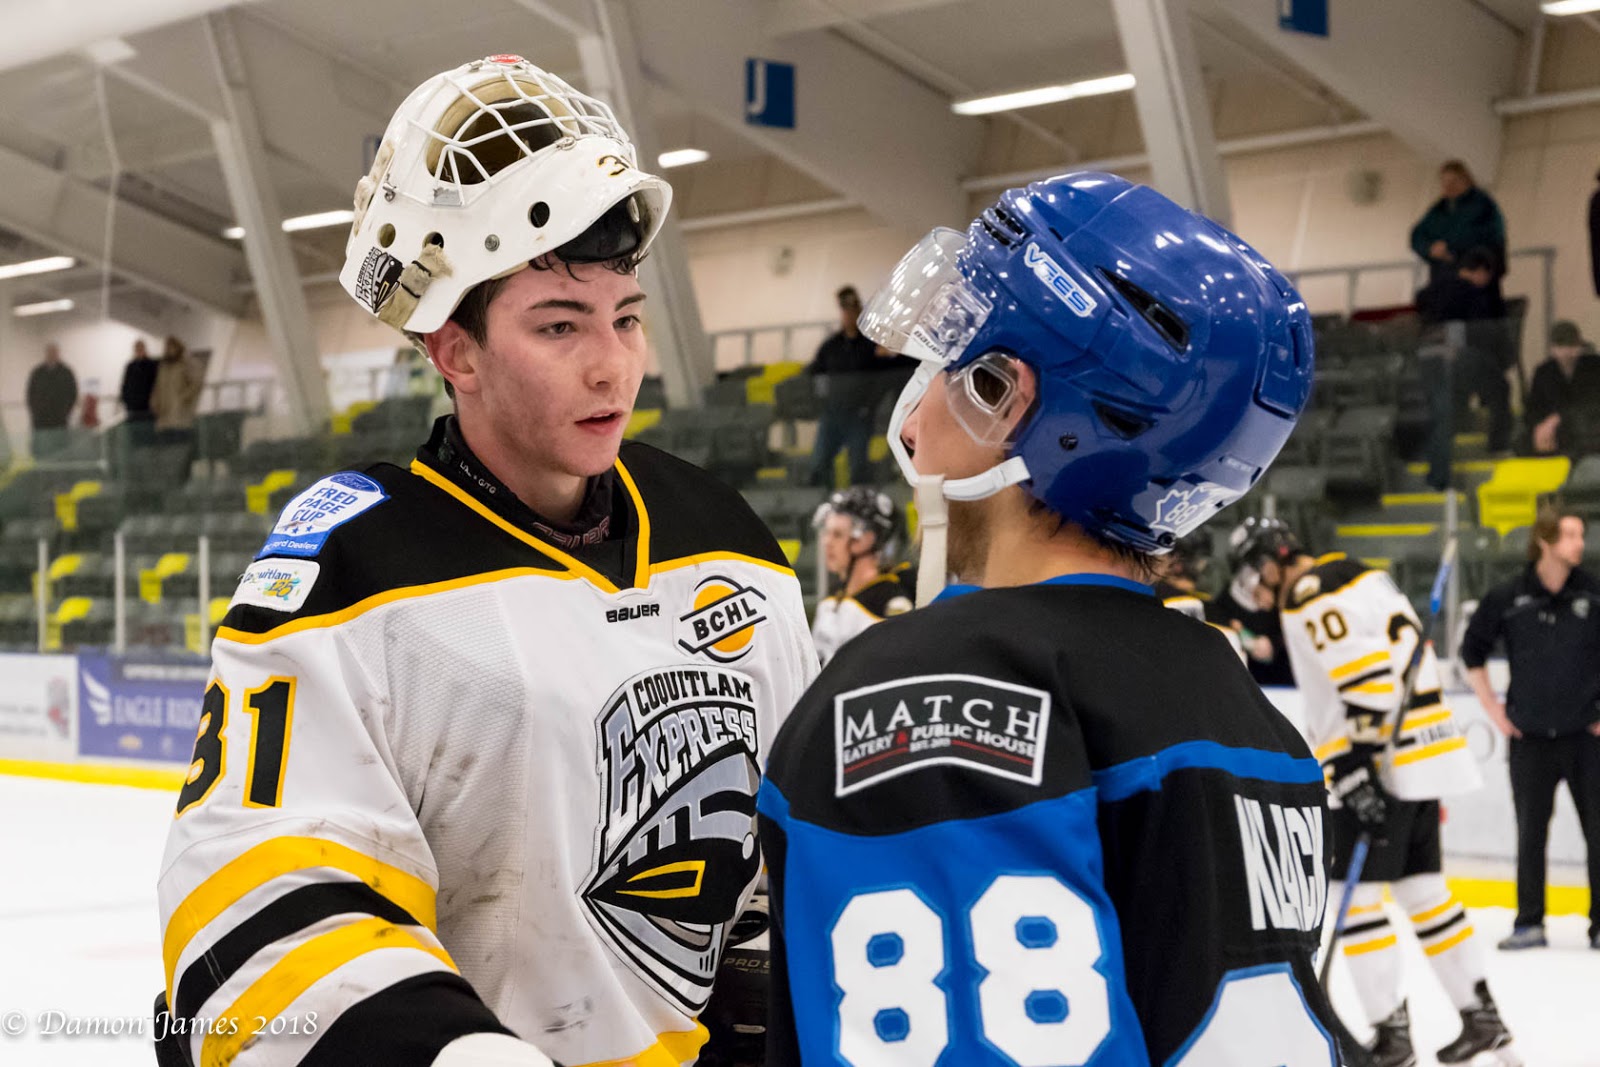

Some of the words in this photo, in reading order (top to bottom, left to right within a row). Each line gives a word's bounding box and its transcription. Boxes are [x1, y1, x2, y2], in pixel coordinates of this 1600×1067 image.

[290, 509, 326, 523] CUP
[298, 498, 346, 515] PAGE
[312, 487, 359, 506] FRED
[1163, 501, 1199, 526] 88
[288, 541, 319, 550] Dealers
[606, 603, 660, 623] BAUER
[692, 597, 758, 641] BCHL
[1305, 608, 1348, 651] 20
[632, 671, 755, 717] COQUITLAM
[844, 694, 1040, 747] MATCH
[844, 733, 894, 764] EATERY
[911, 723, 973, 741] PUBLIC
[976, 730, 1037, 758] HOUSE
[604, 706, 757, 838] EXPRESS
[830, 874, 1112, 1067] 88
